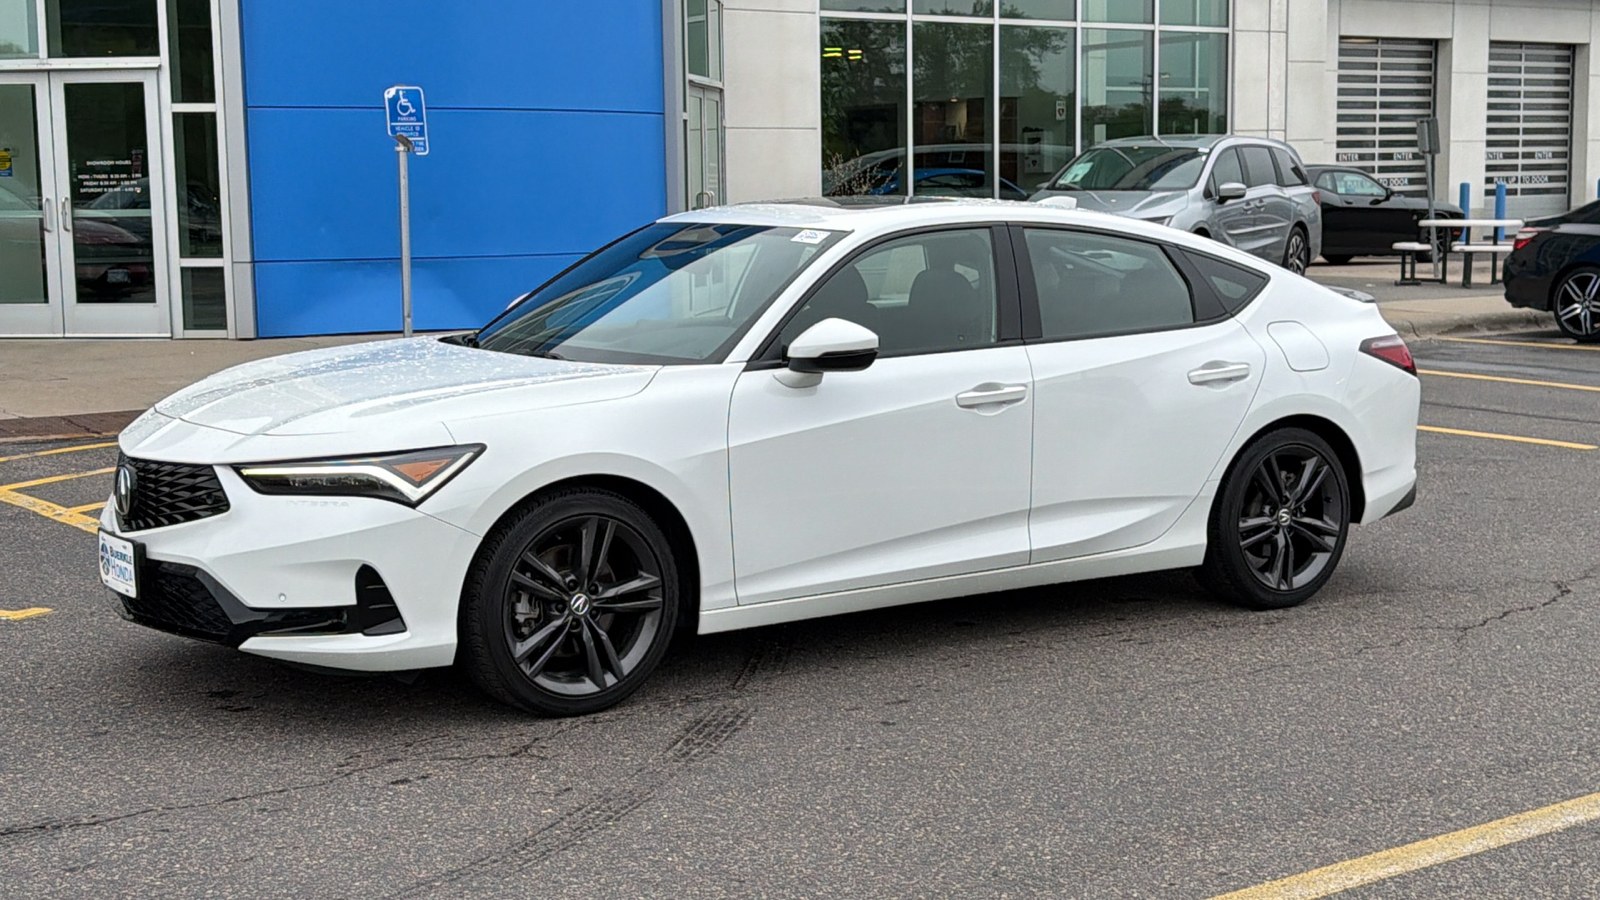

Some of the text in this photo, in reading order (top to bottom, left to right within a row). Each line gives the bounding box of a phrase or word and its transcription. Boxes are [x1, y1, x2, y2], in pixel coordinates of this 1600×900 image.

[1338, 152, 1413, 161] ENTER ENTER
[1485, 151, 1553, 160] ENTER ENTER
[1389, 178, 1409, 186] DOOR
[1508, 176, 1517, 184] UP
[1531, 175, 1549, 183] DOOR
[286, 499, 350, 507] INTEGRA
[109, 545, 132, 565] BUERKLE
[111, 558, 133, 582] HONDA
